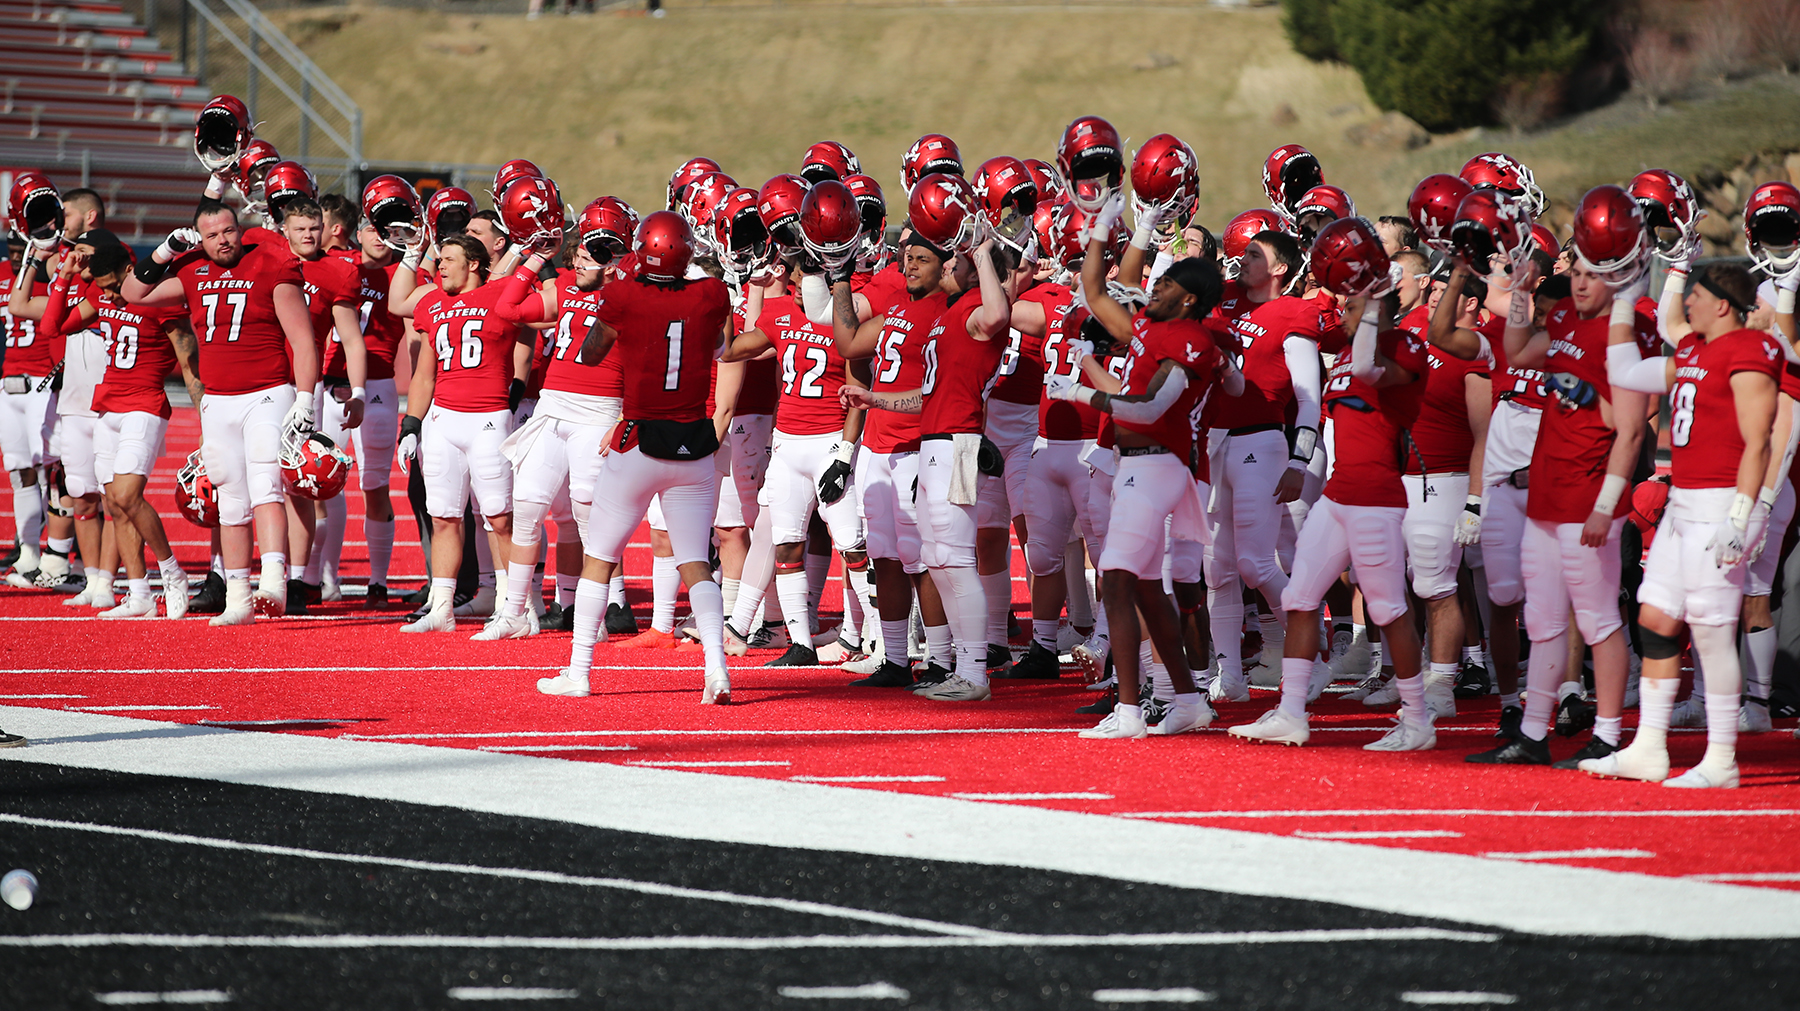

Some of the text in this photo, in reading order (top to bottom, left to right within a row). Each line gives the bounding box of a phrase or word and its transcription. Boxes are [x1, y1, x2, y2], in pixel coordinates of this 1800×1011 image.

[1082, 147, 1115, 158] EQUALITY
[1011, 181, 1035, 194] EQUALITY
[371, 197, 396, 213] EQUALITY
[439, 201, 468, 210] EQUALITY
[769, 216, 795, 231] EQUALITY
[197, 280, 255, 292] EASTERN
[562, 299, 598, 312] EASTE
[98, 306, 143, 325] EASTERN
[201, 292, 248, 343] 77
[433, 307, 489, 324] EASTERN
[435, 318, 484, 372] 46
[780, 329, 834, 348] EASTERN
[663, 319, 685, 392] 1
[781, 342, 829, 399] 42
[1506, 366, 1546, 382] EAST
[893, 394, 922, 410] FAMIL
